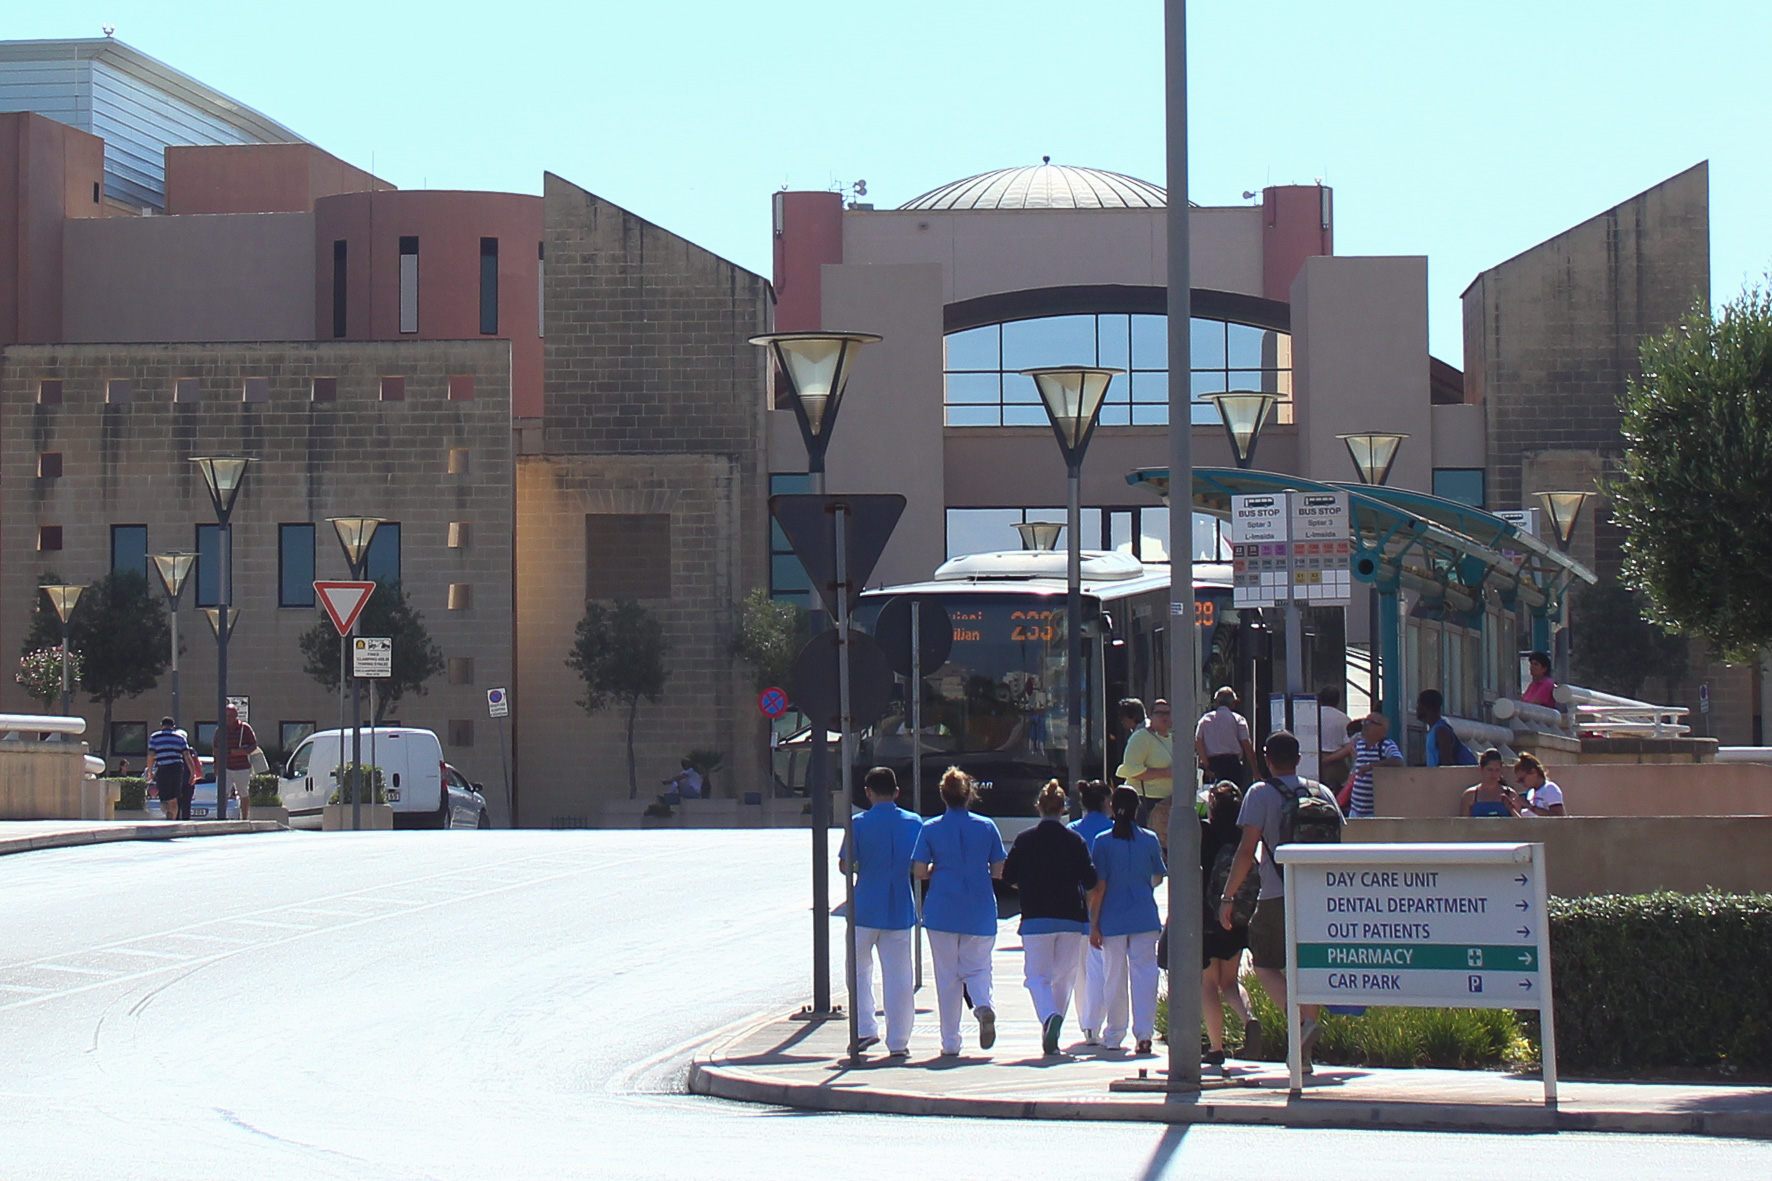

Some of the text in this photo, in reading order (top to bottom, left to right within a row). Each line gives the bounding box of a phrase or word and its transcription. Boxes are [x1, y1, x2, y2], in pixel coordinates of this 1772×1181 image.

[1257, 509, 1280, 517] STOP
[1318, 507, 1341, 515] STOP
[1326, 872, 1439, 887] DAY CARE UNIT
[1327, 898, 1488, 913] DENTAL DEPARTMENT
[1327, 923, 1430, 939] OUT PATIENTS
[1327, 948, 1414, 964] PHARMACY
[1328, 973, 1401, 990] CAR PARK
